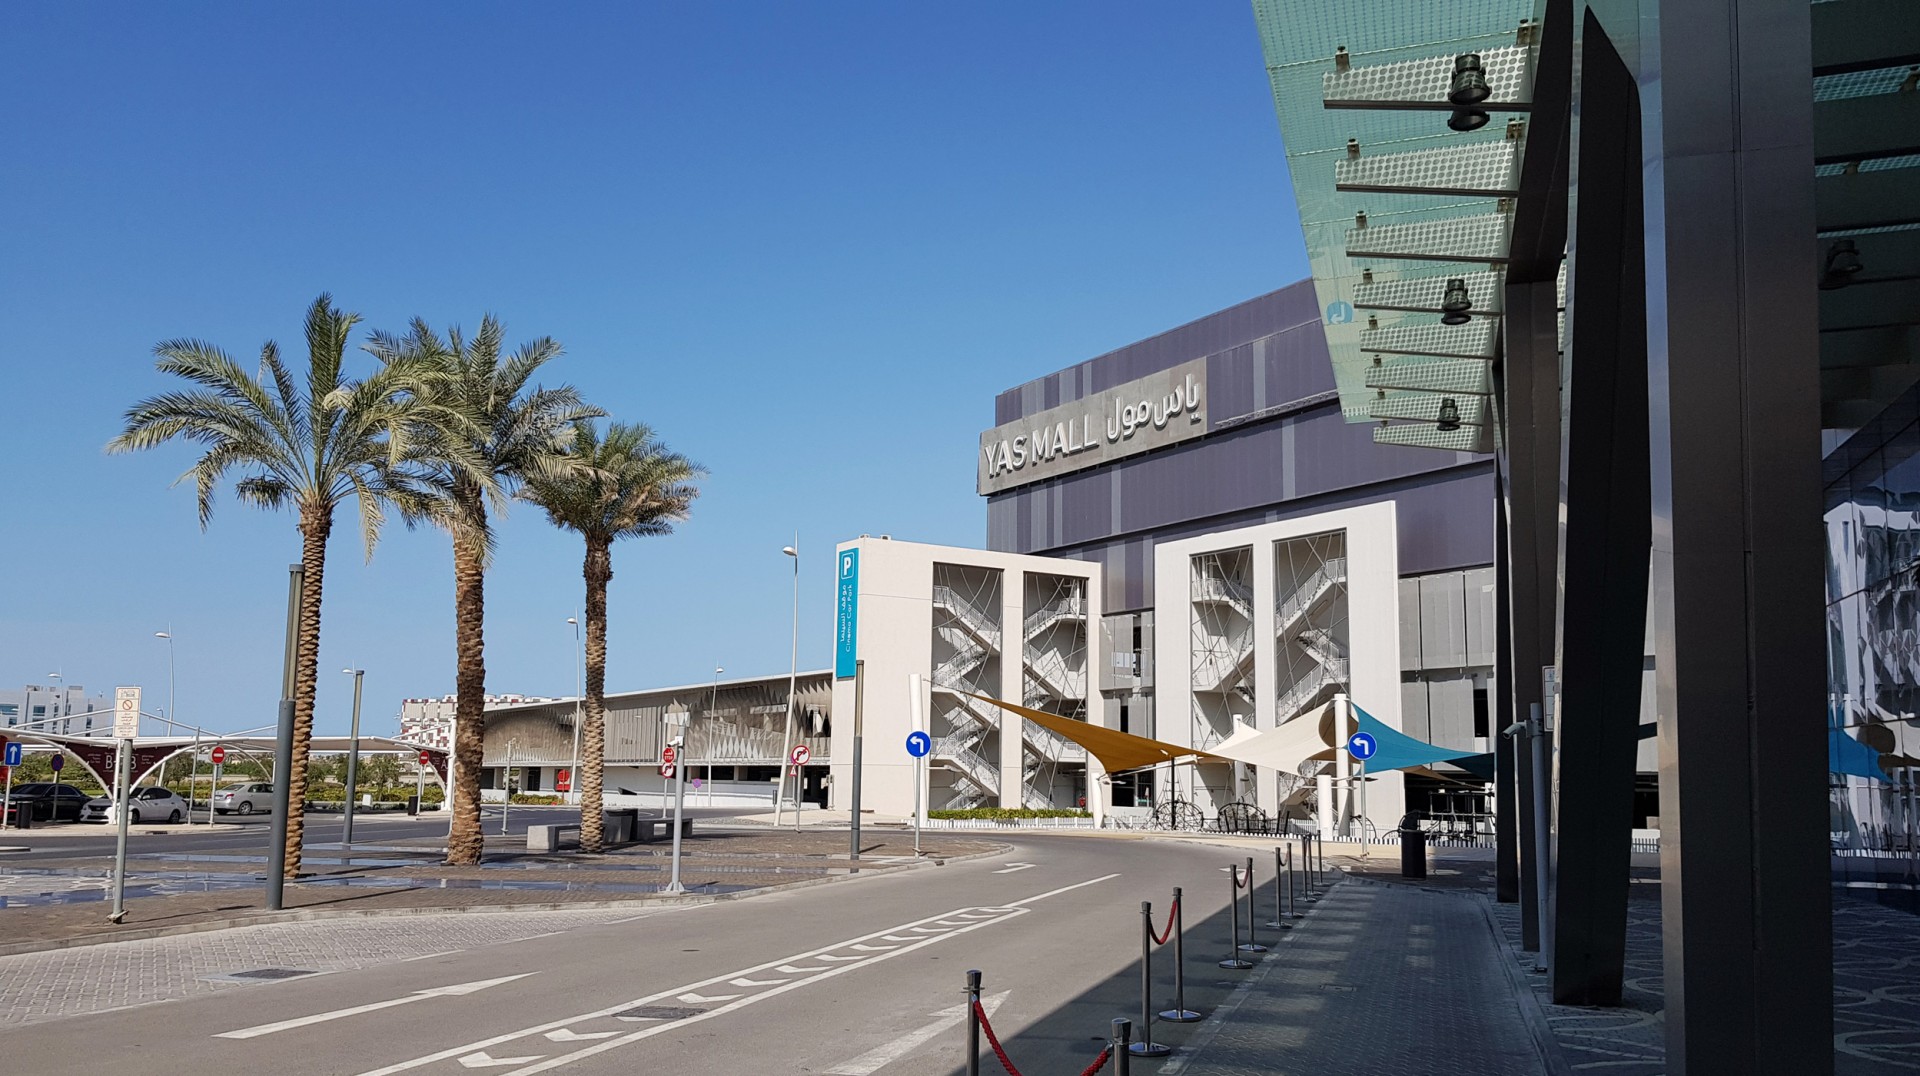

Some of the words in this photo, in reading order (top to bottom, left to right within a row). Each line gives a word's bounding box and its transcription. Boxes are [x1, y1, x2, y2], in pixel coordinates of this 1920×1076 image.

[1106, 396, 1152, 441] مول
[1153, 373, 1200, 428] ياس
[985, 434, 1027, 478] YAS
[1031, 414, 1099, 464] MALL
[843, 556, 851, 576] P
[106, 755, 113, 769] B
